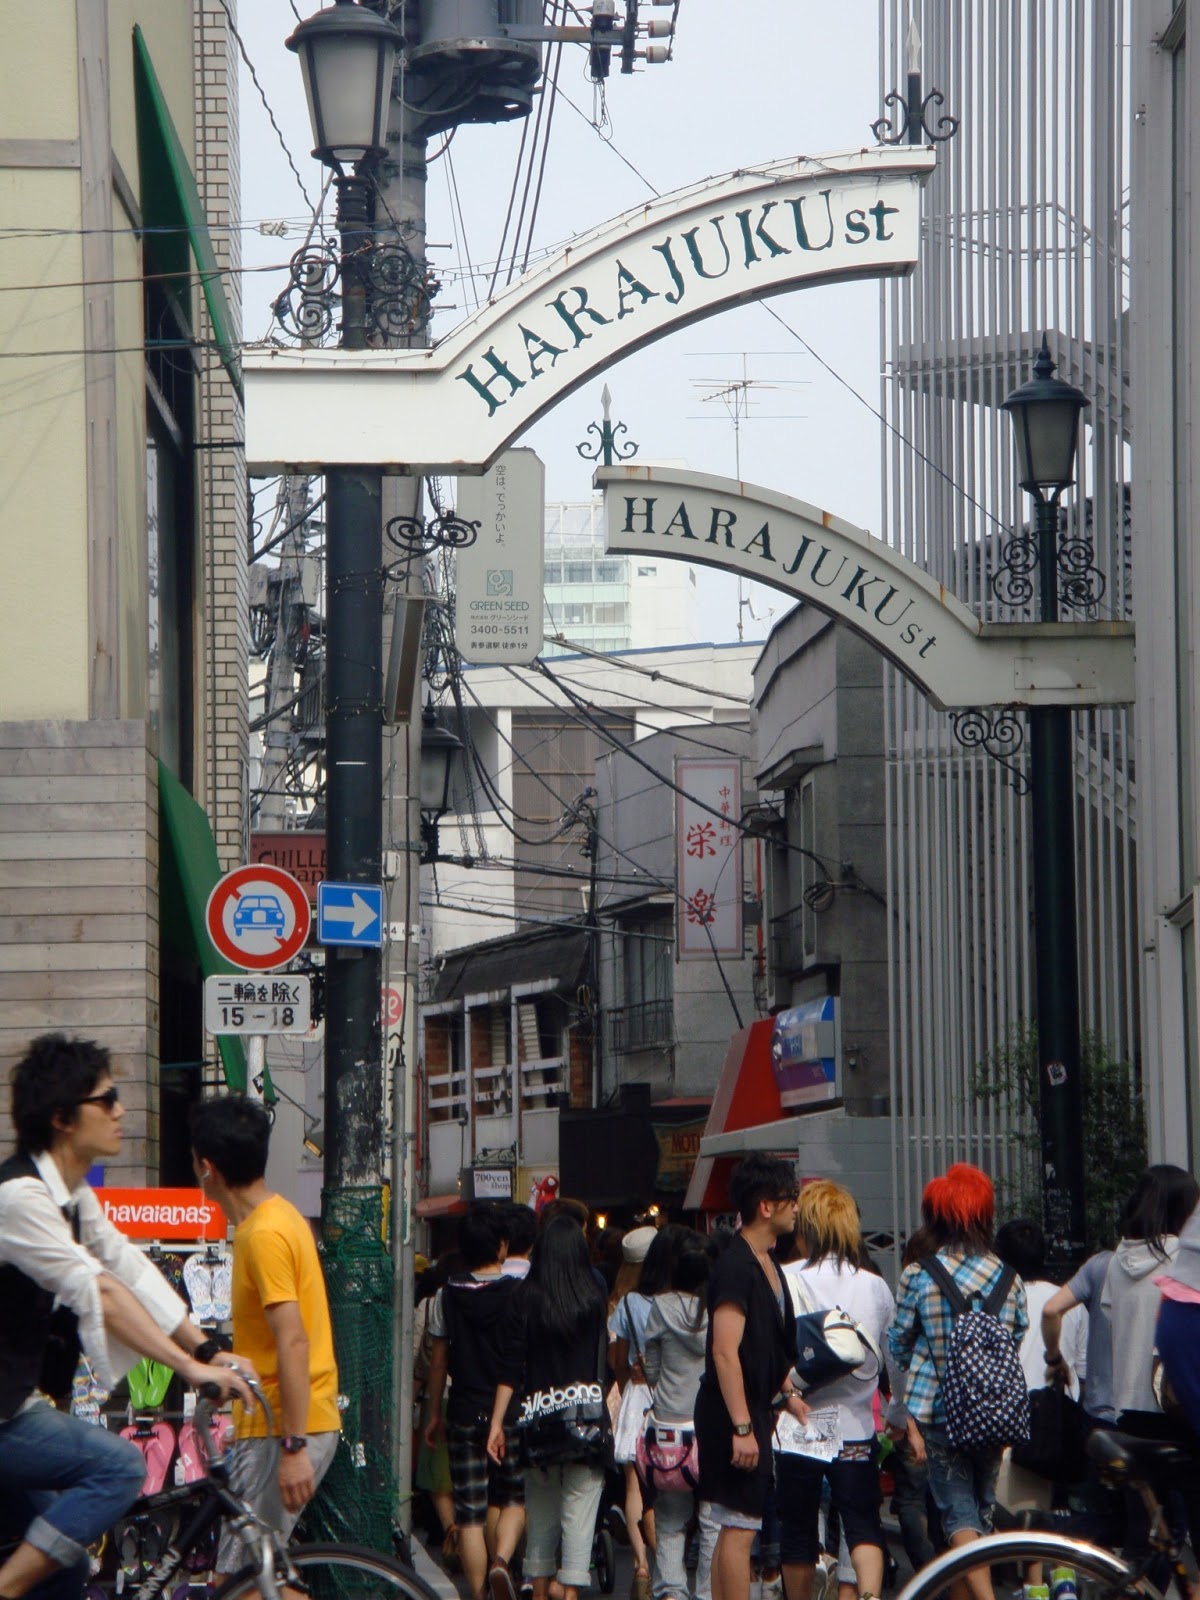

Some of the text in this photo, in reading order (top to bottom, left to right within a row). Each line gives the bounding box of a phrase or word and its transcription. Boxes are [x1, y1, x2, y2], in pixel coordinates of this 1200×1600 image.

[455, 188, 834, 418] HARAJUKU
[620, 496, 916, 626] HARAJUKU
[469, 601, 530, 611] GREEN SEED
[470, 624, 529, 635] 3400-5511
[217, 981, 300, 1003] 二輪を除く
[104, 1201, 212, 1225] havaianas
[520, 1384, 603, 1416] illabong
[542, 1408, 555, 1416] YOU
[554, 1401, 573, 1411] WANT
